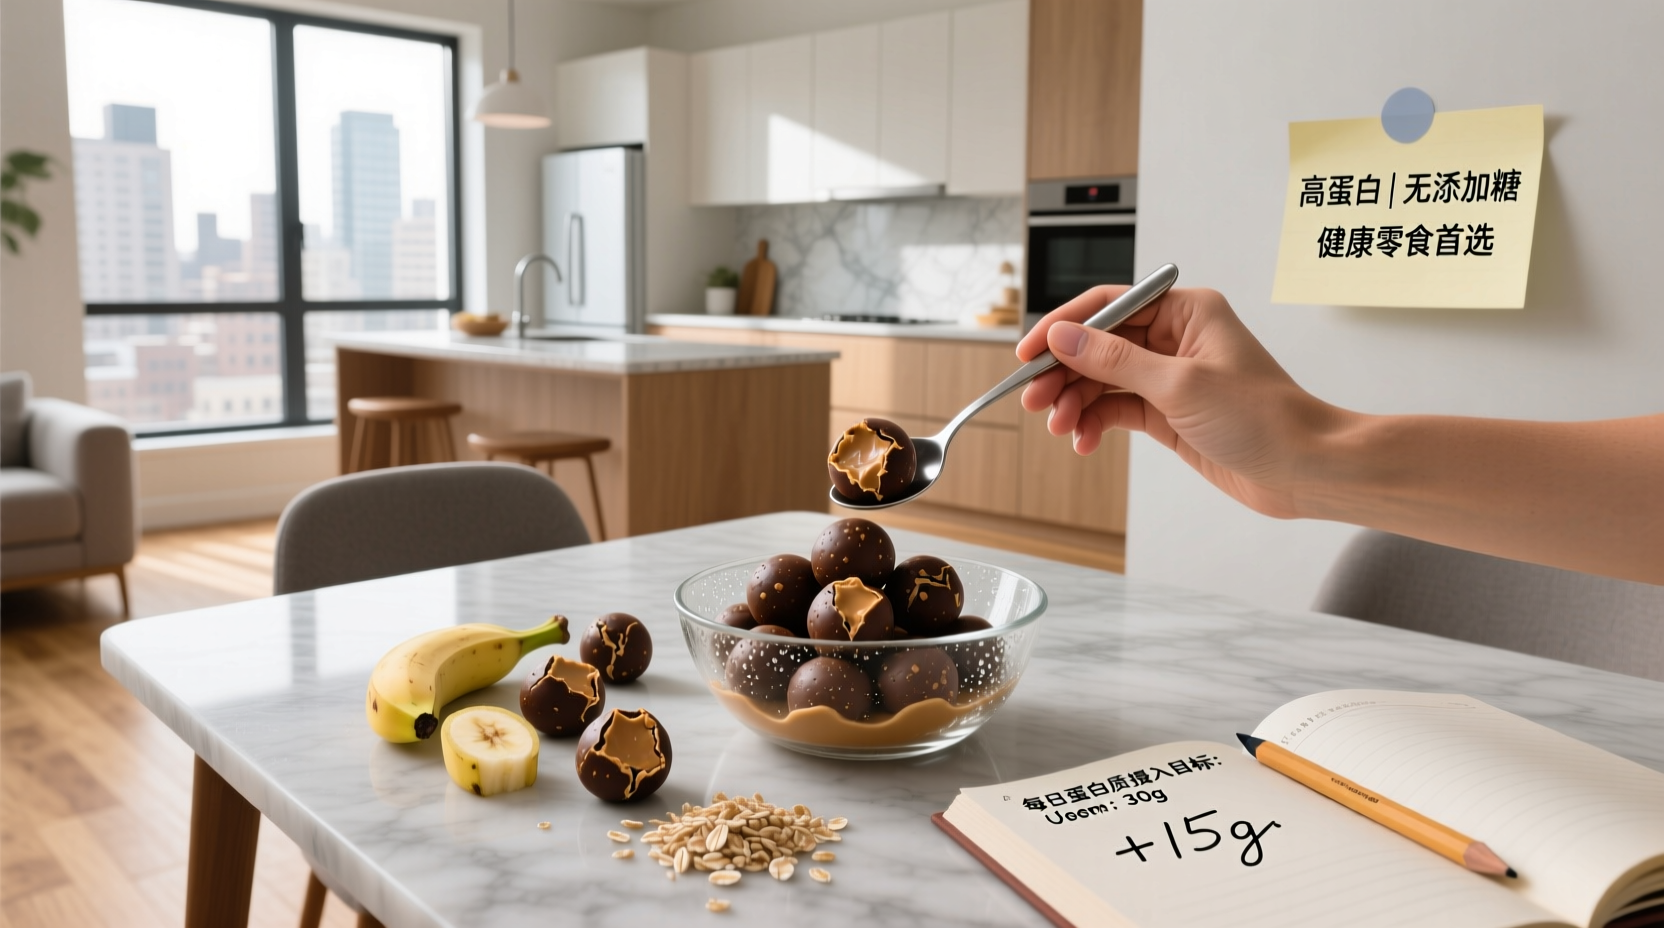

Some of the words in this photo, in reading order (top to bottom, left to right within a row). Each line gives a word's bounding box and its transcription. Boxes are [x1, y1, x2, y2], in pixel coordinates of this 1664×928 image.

[1317, 222, 1495, 259] 健康零食首选
[1122, 789, 1168, 806] 30g
